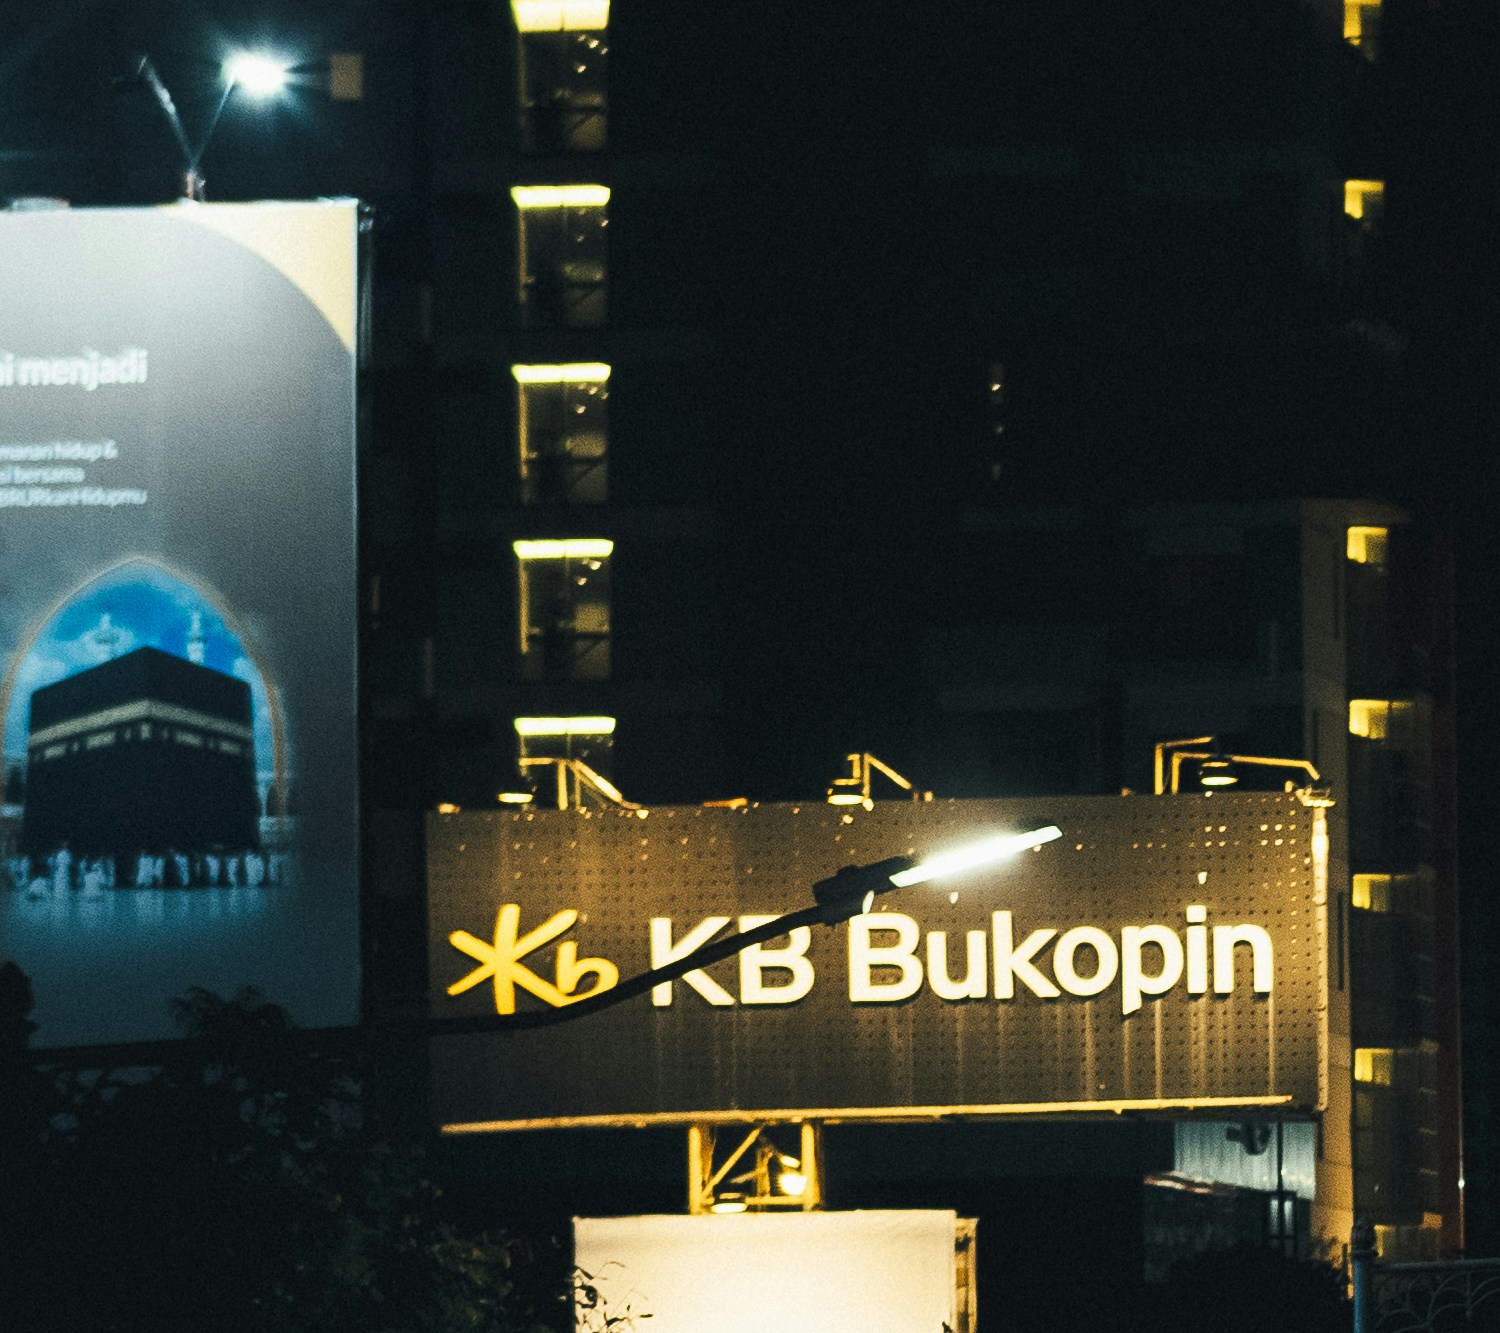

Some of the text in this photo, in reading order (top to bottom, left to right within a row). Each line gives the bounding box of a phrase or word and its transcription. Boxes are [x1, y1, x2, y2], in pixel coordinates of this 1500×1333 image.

[19, 349, 149, 391] menjadi
[650, 904, 1274, 1016] KB Bukopin
